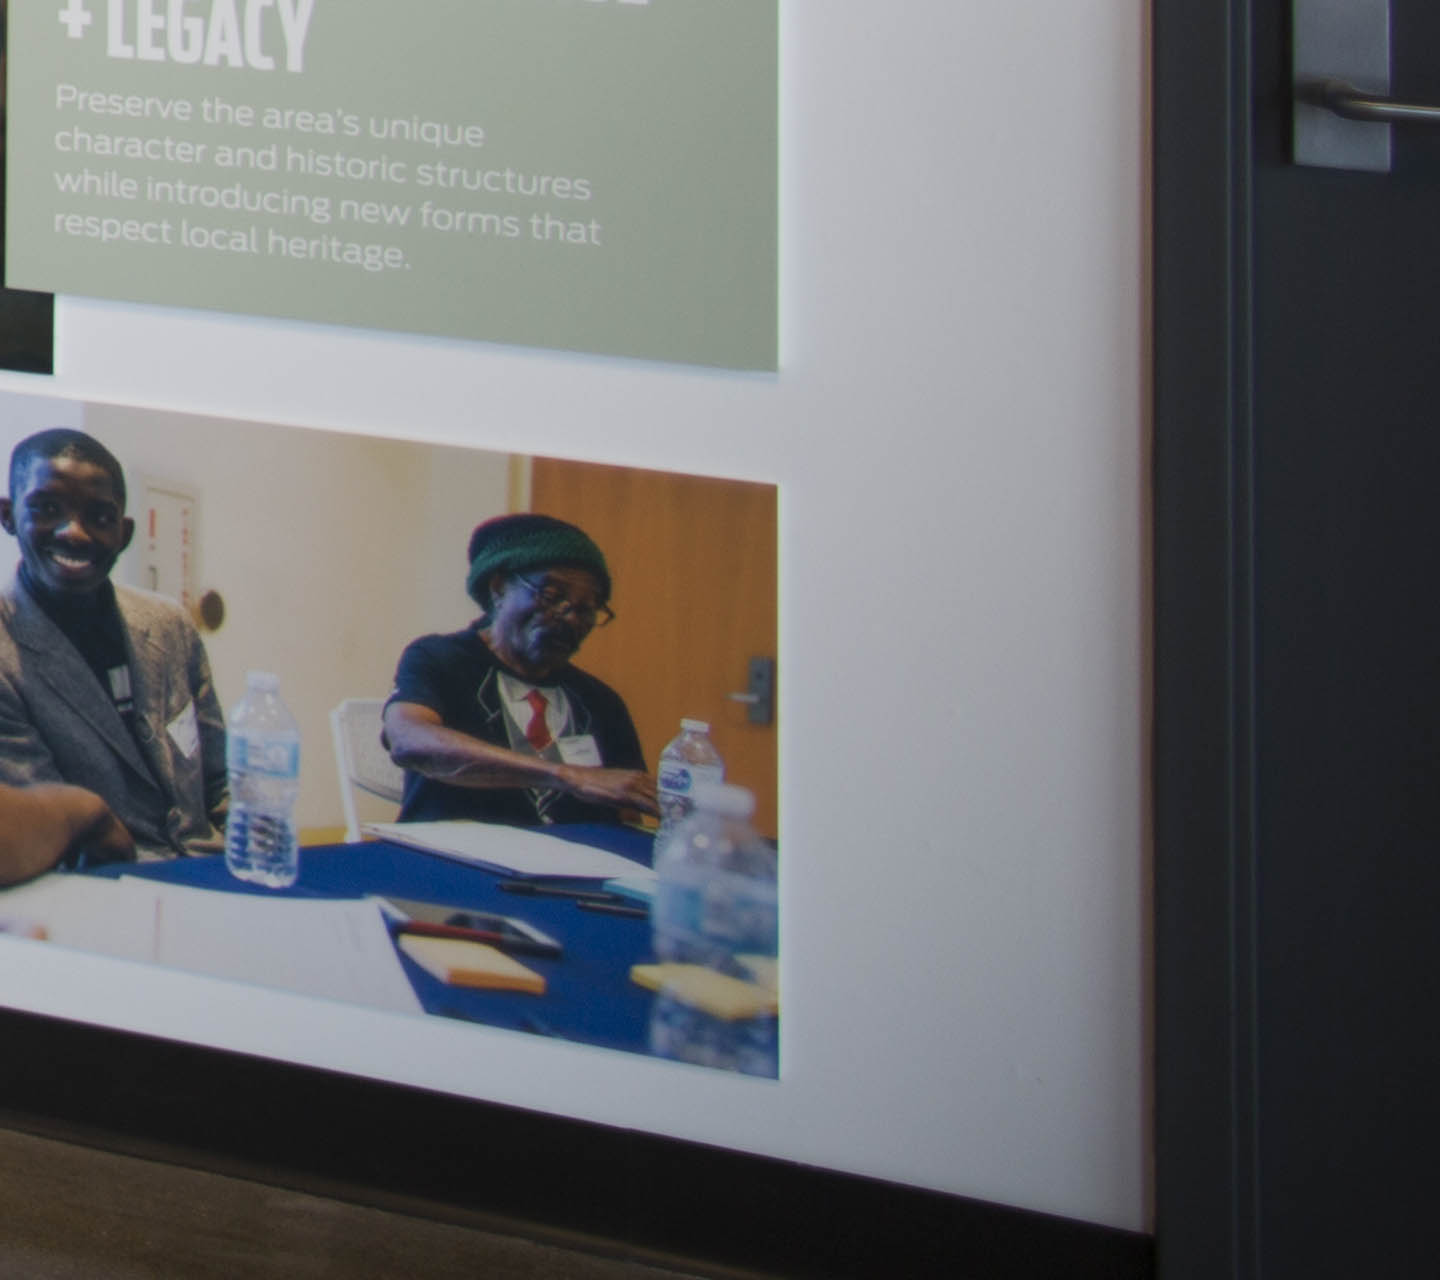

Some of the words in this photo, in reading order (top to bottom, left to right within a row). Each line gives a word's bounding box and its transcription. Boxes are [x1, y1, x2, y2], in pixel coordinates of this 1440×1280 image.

[55, 83, 192, 121] Preserve
[200, 96, 254, 127] the
[369, 115, 484, 149] unique
